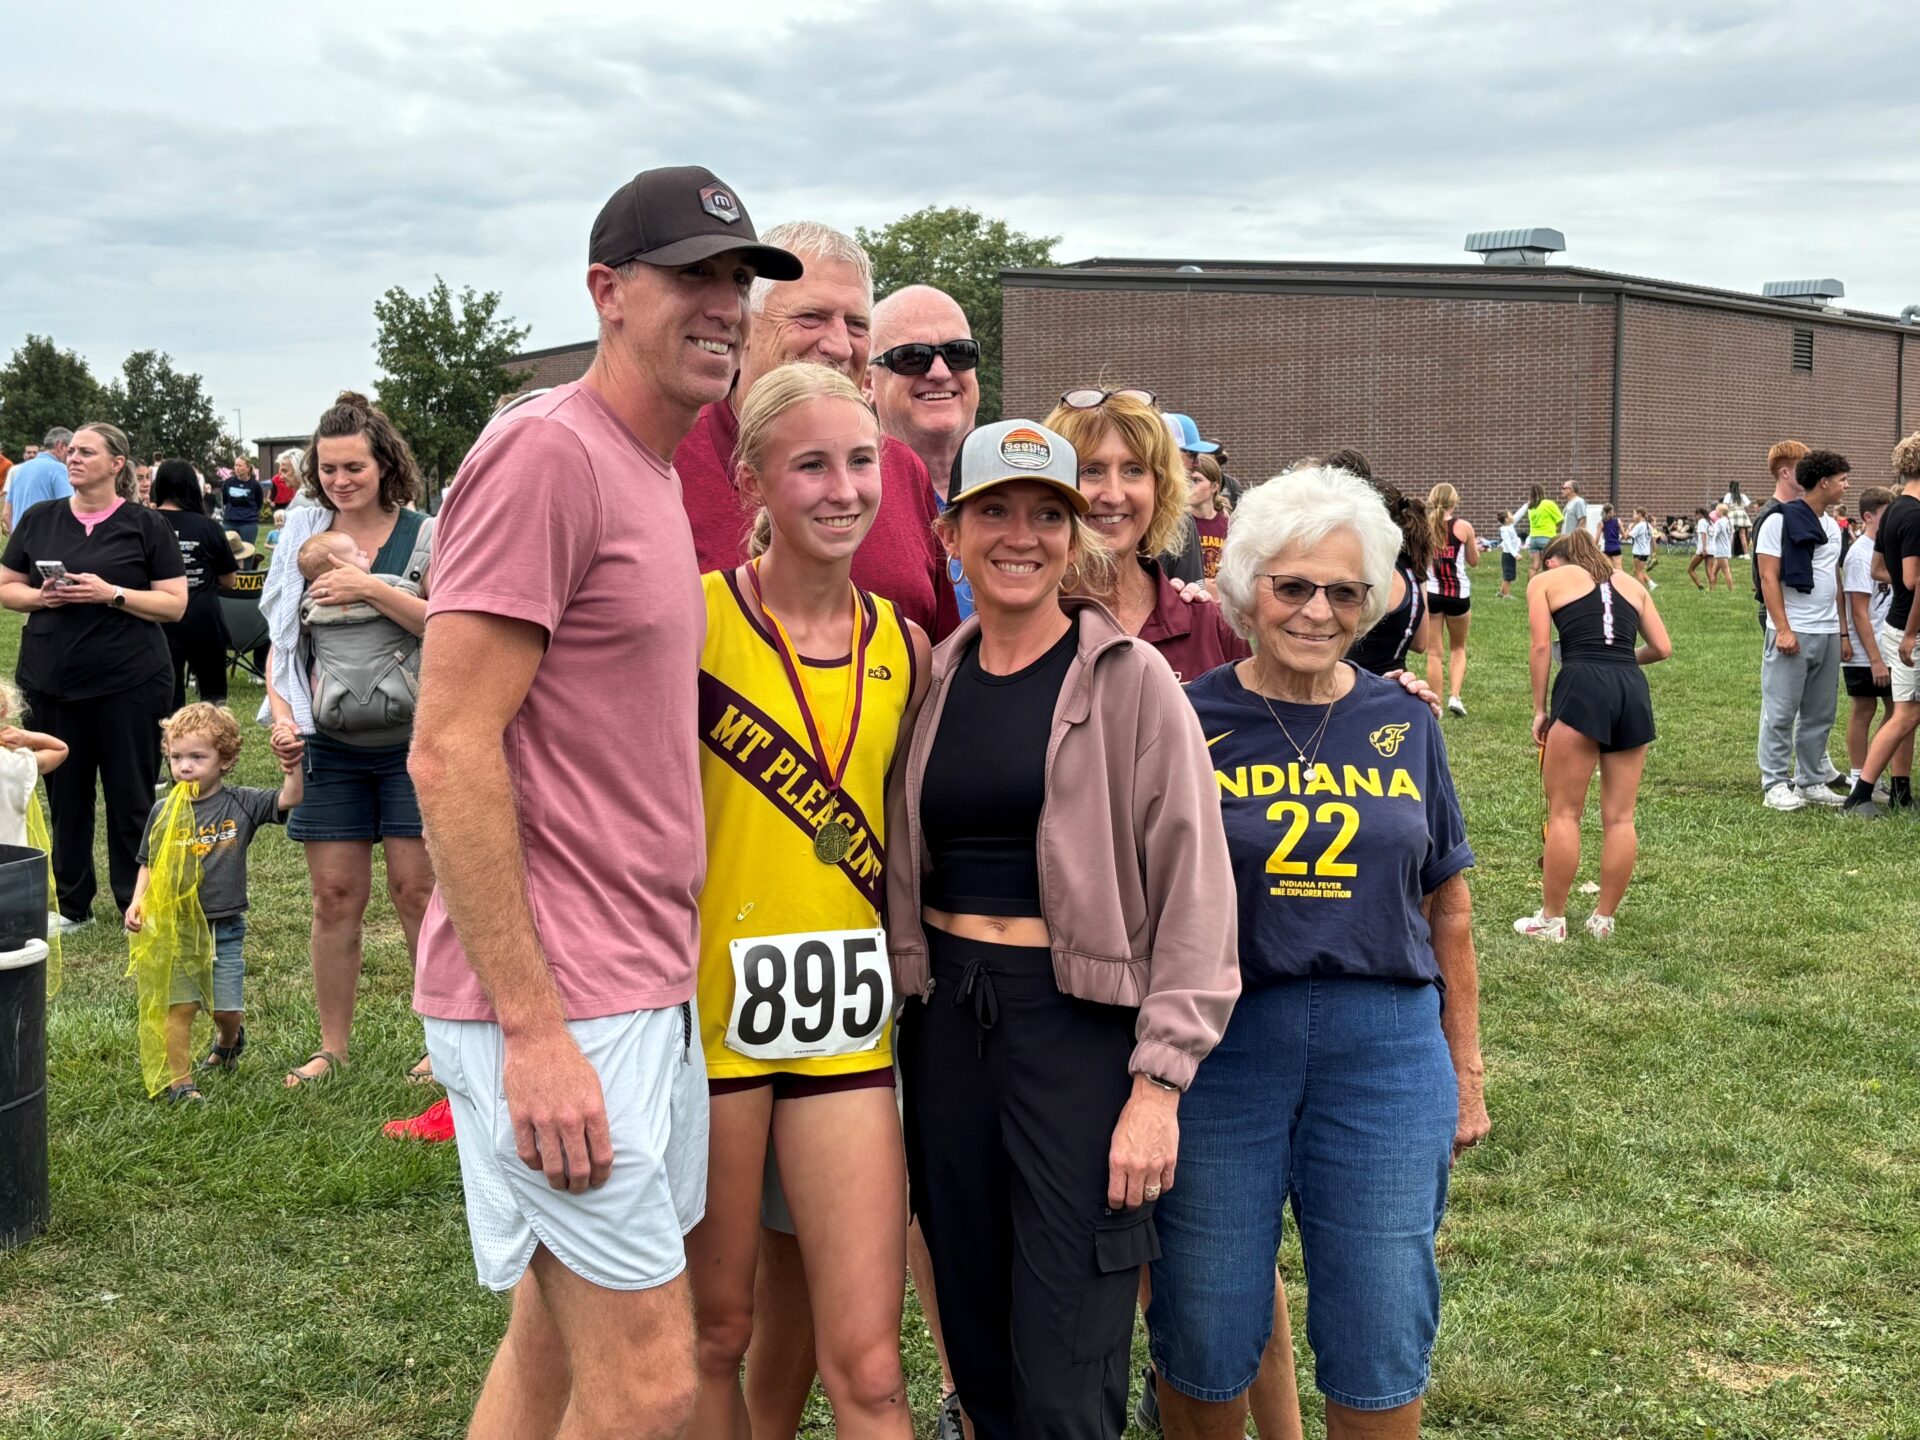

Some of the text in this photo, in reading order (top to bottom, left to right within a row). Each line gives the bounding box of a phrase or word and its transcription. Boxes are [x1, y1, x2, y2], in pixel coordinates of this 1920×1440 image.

[709, 703, 774, 763] MT
[1214, 763, 1421, 801] NDIANA
[176, 819, 236, 839] OWA
[1265, 801, 1359, 877] 22
[1280, 880, 1342, 889] INDIANA FEVER
[1287, 888, 1321, 897] EXPLORER
[1323, 890, 1352, 898] EDITION
[737, 937, 884, 1046] 895
